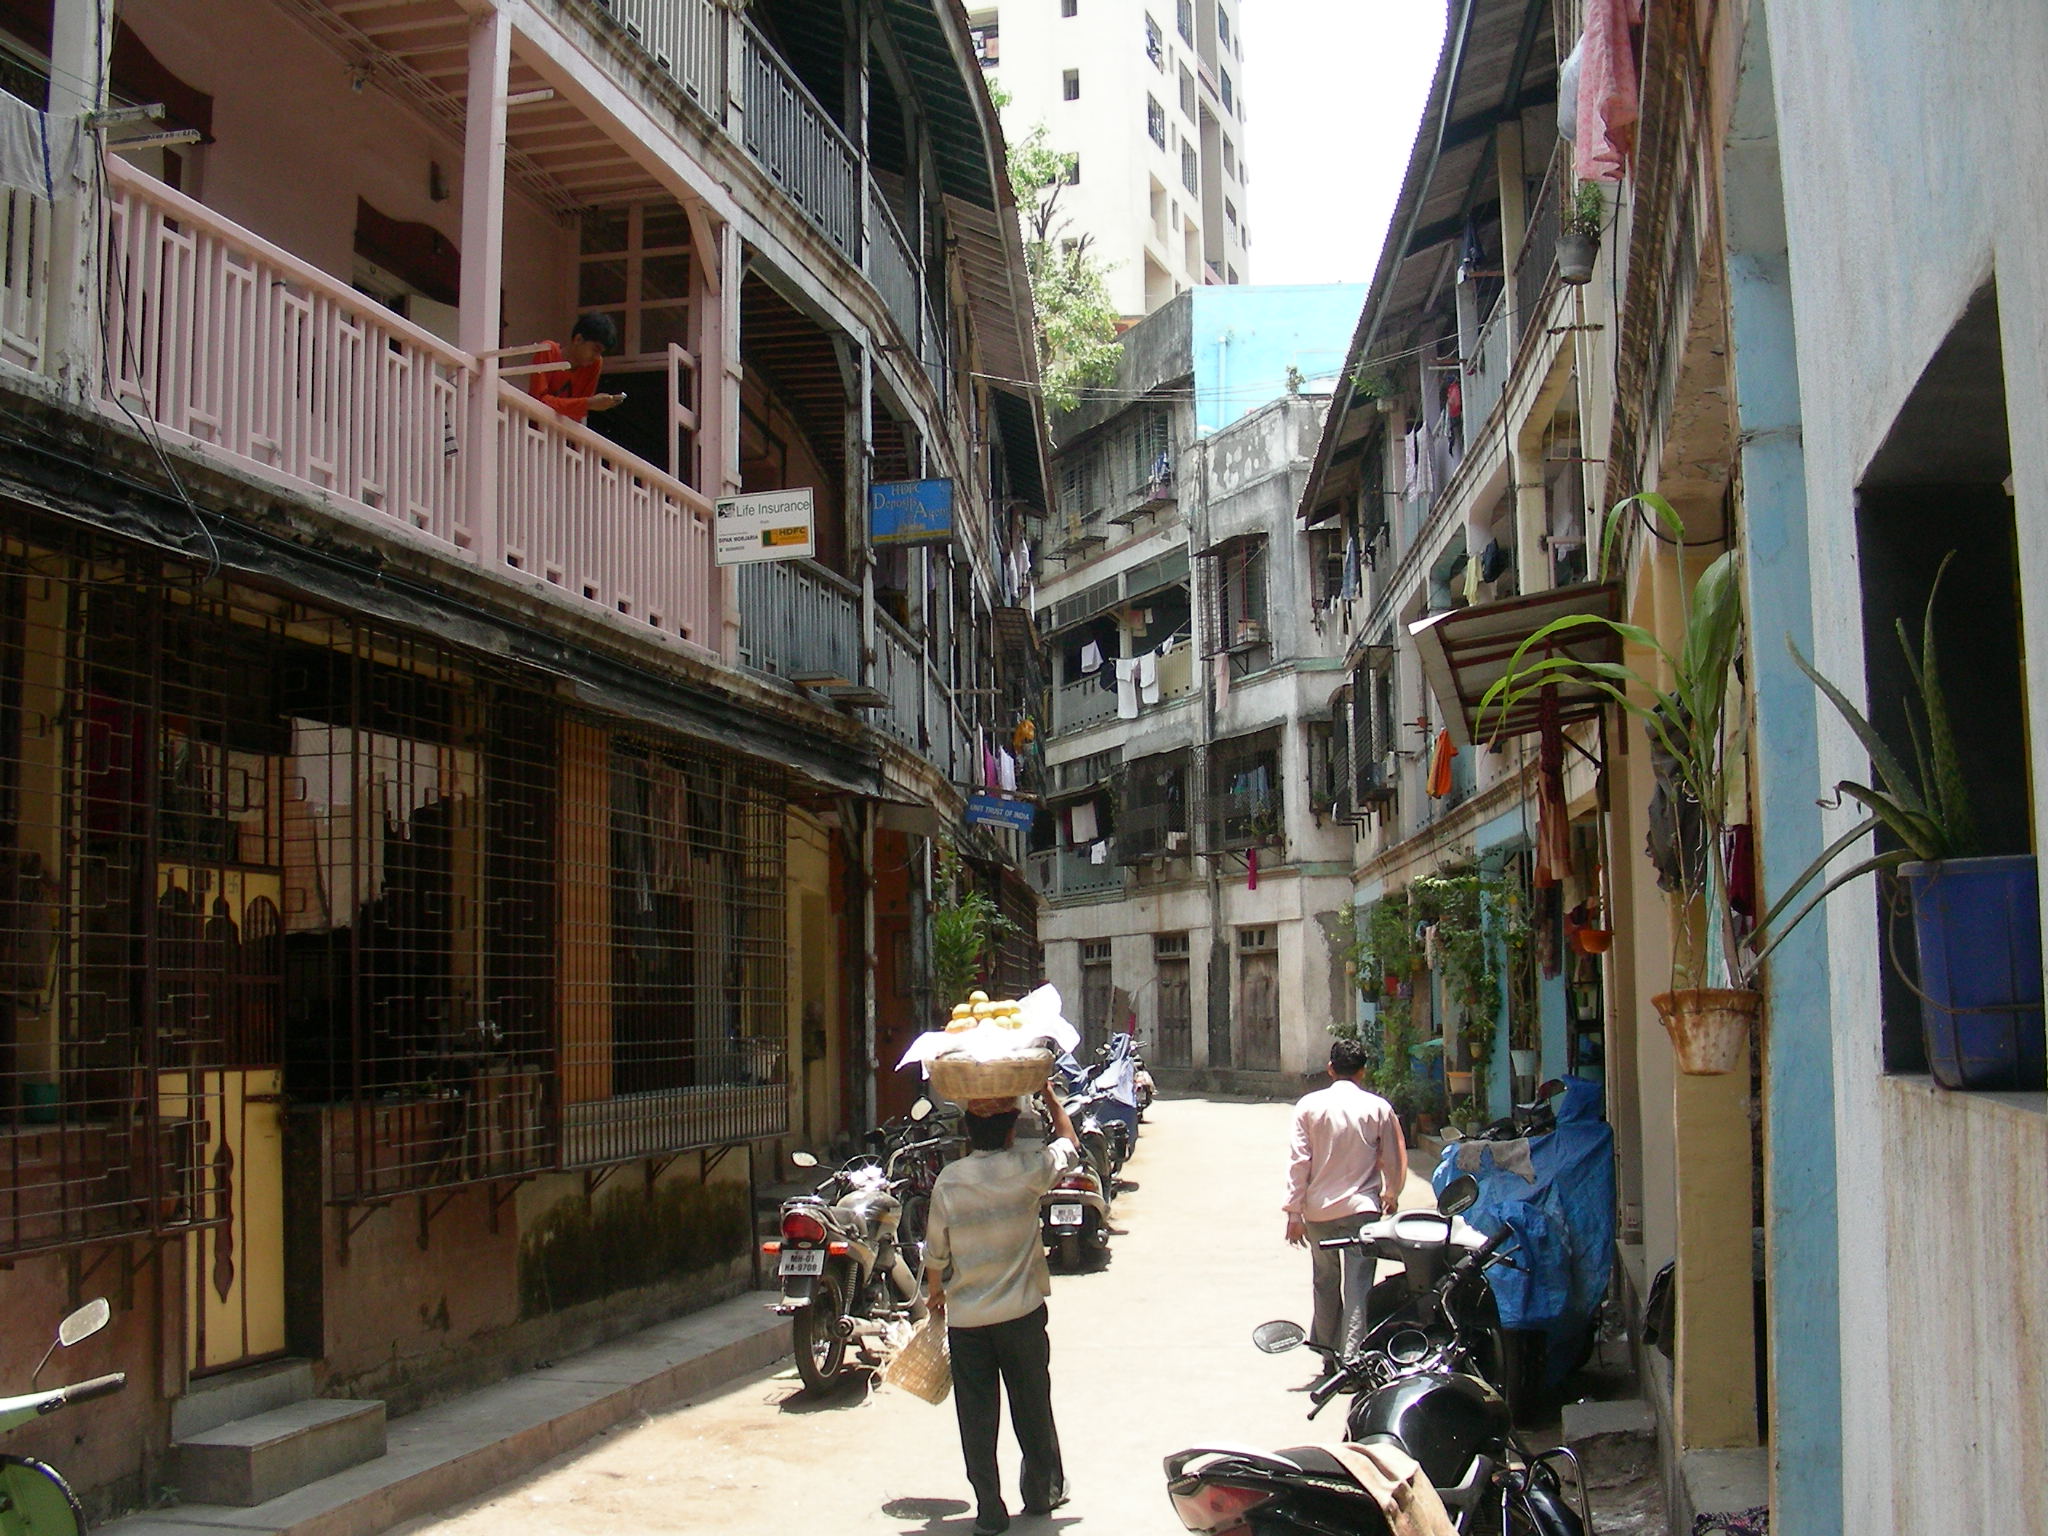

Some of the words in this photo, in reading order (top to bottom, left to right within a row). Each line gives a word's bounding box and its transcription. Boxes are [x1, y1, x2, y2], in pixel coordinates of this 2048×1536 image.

[736, 503, 755, 518] Life
[758, 500, 811, 515] Insurance
[778, 527, 806, 536] HDFC
[985, 806, 1004, 816] TRUST
[1004, 809, 1013, 817] OF
[1013, 811, 1030, 821] INDIA
